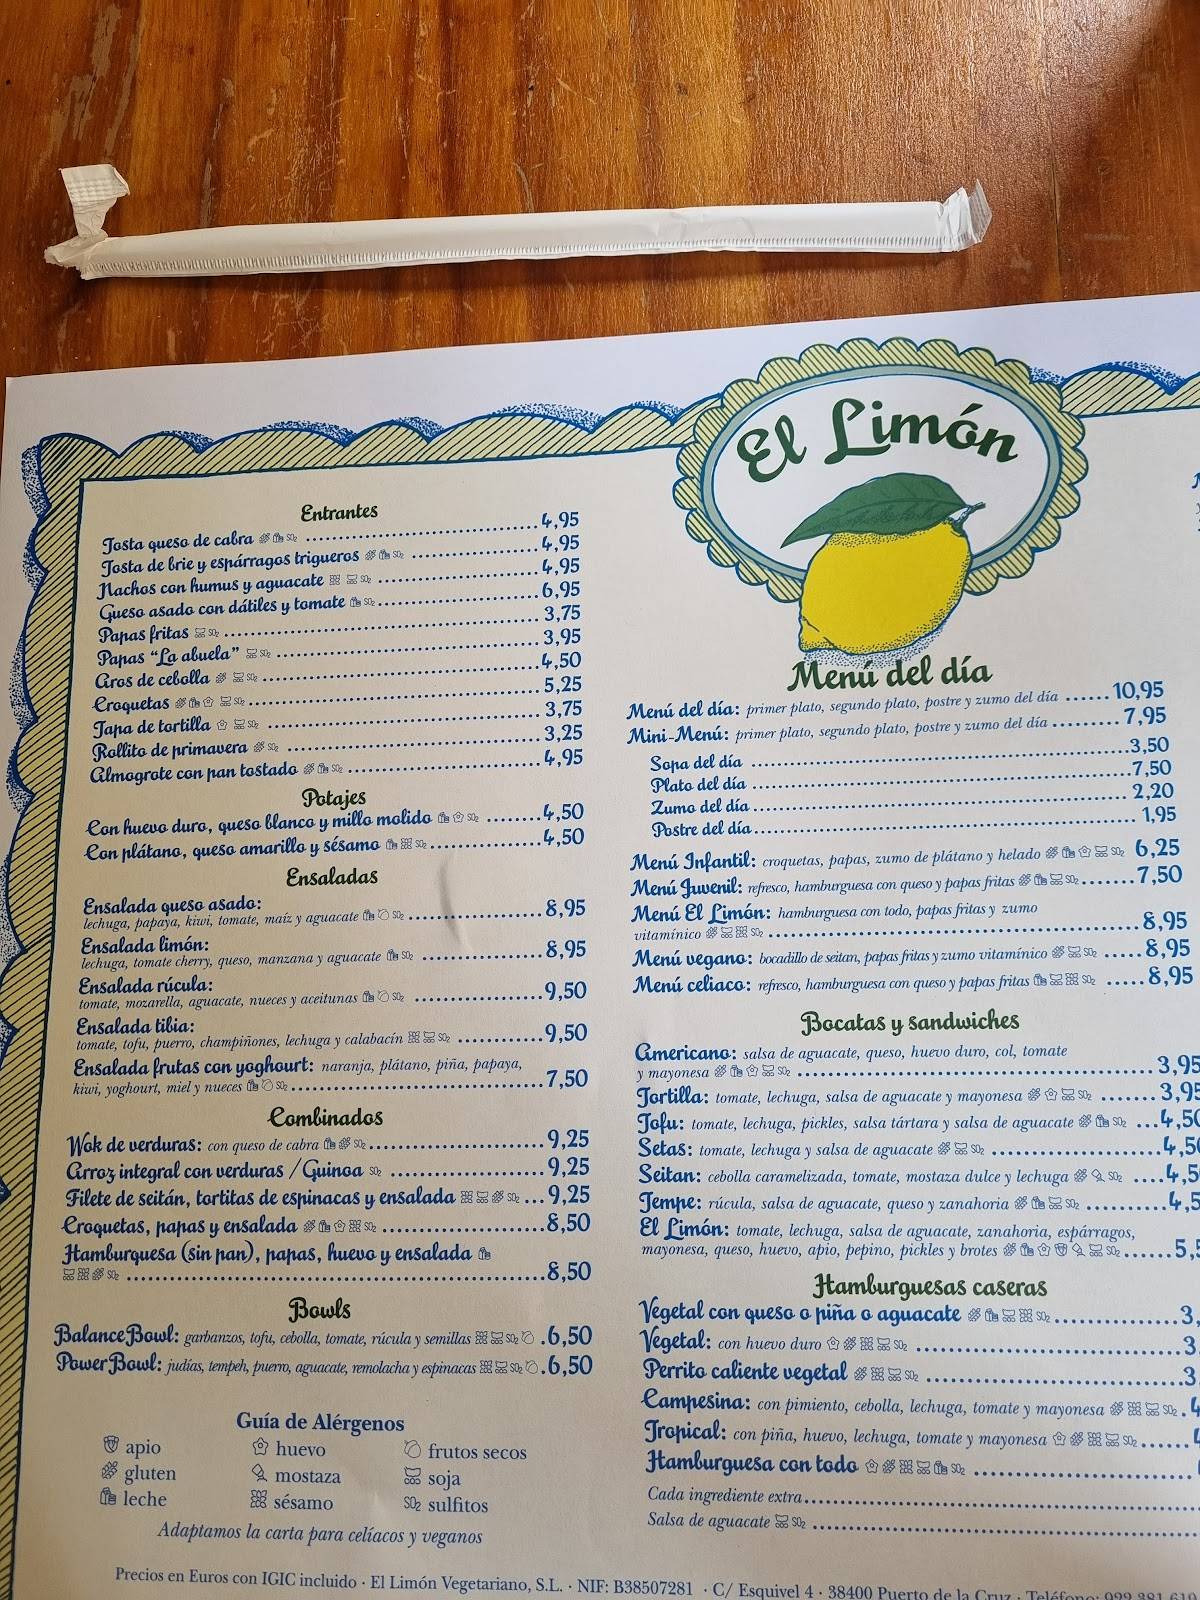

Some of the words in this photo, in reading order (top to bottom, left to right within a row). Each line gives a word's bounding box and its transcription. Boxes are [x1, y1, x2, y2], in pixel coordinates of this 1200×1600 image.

[736, 414, 807, 483] El
[823, 398, 1019, 465] Limón
[301, 503, 378, 522] Entrantes
[102, 537, 146, 555] Tosta
[148, 537, 190, 554] queso
[192, 533, 211, 548] de
[214, 530, 255, 547] cabra
[541, 511, 579, 530] 4,95
[101, 559, 145, 578] Tosta
[147, 558, 165, 572] de
[168, 555, 195, 572] brie
[197, 561, 208, 574] y
[210, 553, 291, 572] espárragos
[294, 550, 360, 568] trigueros
[542, 534, 580, 553] 4,95
[96, 579, 156, 601] Nachos
[160, 584, 188, 595] con
[190, 576, 239, 593] humus
[243, 581, 253, 595] y
[255, 573, 325, 594] aguacate
[542, 557, 580, 576] 4,95
[97, 649, 145, 669] Papas
[543, 628, 581, 647] 3,95
[786, 659, 880, 692] Menú
[886, 654, 1034, 688] del
[940, 655, 994, 685] día
[91, 696, 170, 715] Croquetas
[544, 675, 582, 695] 5,25
[626, 702, 676, 720] Menú
[678, 699, 704, 718] del
[707, 700, 740, 717] día:
[746, 703, 788, 719] primer
[789, 701, 824, 717] plato,
[829, 698, 881, 715] segundo
[883, 697, 920, 713] plato,
[924, 696, 962, 712] postre
[964, 697, 972, 710] y
[975, 696, 1010, 705] zumo
[1014, 691, 1034, 703] del
[1036, 690, 1059, 702] día
[1112, 680, 1164, 701] 10,95
[650, 755, 691, 774] Sopa
[693, 753, 716, 770] del
[718, 754, 744, 769] día
[1129, 736, 1170, 755] 3,50
[650, 777, 695, 794] Plato
[696, 775, 720, 792] del
[722, 776, 747, 791] día
[1132, 759, 1172, 778] 7,50
[301, 787, 367, 811] Potajes
[83, 843, 119, 861] Con
[121, 842, 187, 863] plátano,
[192, 844, 237, 861] queso
[239, 836, 307, 856] amarillo
[310, 843, 320, 858] y
[323, 835, 382, 853] sésamo
[543, 827, 585, 848] 4,50
[286, 866, 378, 887] Ensaladas
[83, 896, 158, 916] Ensalada
[161, 899, 206, 917] queso
[208, 894, 261, 911] asado:
[83, 917, 130, 933] lechuga,
[134, 917, 181, 932] papaya,
[185, 914, 213, 928] kiwi,
[218, 915, 259, 927] tomate,
[265, 912, 292, 924] maíz
[294, 915, 302, 927] y
[305, 911, 359, 927] aguacate
[545, 898, 586, 919] 8,95
[631, 949, 683, 967] Menú
[686, 953, 753, 971] vegano:
[759, 951, 808, 965] bocadillo
[810, 951, 824, 964] de
[824, 950, 861, 965] seitan,
[863, 951, 899, 967] papas
[898, 949, 931, 966] fritas
[931, 952, 939, 966] y
[940, 951, 976, 961] zumo
[978, 947, 1048, 960] vitamínico
[1145, 938, 1191, 960] 8,95
[76, 1016, 153, 1036] Ensalada
[155, 1015, 195, 1034] tibia:
[800, 1010, 886, 1037] Bocatas
[891, 1019, 904, 1037] y
[908, 1008, 1020, 1031] sandwiches
[267, 1106, 383, 1128] Combinados
[66, 1131, 103, 1158] Wok
[105, 1136, 126, 1153] de
[129, 1135, 202, 1152] verduras:
[207, 1142, 228, 1152] con
[232, 1142, 265, 1156] queso
[269, 1138, 283, 1151] de
[286, 1138, 320, 1151] cabra
[547, 1129, 589, 1151] 9,25
[638, 1137, 692, 1158] Setas:
[699, 1145, 745, 1159] tomate,
[751, 1143, 801, 1160] lechuga
[804, 1146, 811, 1160] y
[815, 1142, 850, 1156] salsa
[853, 1142, 869, 1156] de
[872, 1144, 933, 1160] aguacate
[638, 1191, 702, 1214] Tempe:
[709, 1196, 756, 1212] rúcula,
[761, 1196, 795, 1210] salsa
[799, 1196, 814, 1210] de
[817, 1198, 881, 1214] aguacate,
[887, 1200, 924, 1215] queso
[927, 1200, 935, 1214] y
[939, 1196, 1009, 1210] zanahoria
[812, 1272, 967, 1302] Hamburguesas
[972, 1280, 1048, 1297] caseras
[288, 1296, 351, 1324] Bowls
[642, 1357, 708, 1379] Perrito
[711, 1359, 780, 1380] caliente
[783, 1360, 848, 1387] vegetal
[236, 1411, 280, 1429] Guía
[285, 1412, 308, 1430] de
[311, 1413, 405, 1437] Alérgenos
[126, 1439, 161, 1460] apio
[276, 1440, 326, 1457] huevo
[428, 1443, 478, 1459] frutos
[483, 1448, 527, 1460] secos
[124, 1464, 176, 1486] gluten
[275, 1470, 341, 1484] mostaza
[428, 1469, 462, 1491] soja
[123, 1490, 167, 1507] leche
[274, 1493, 333, 1511] sésamo
[428, 1496, 488, 1513] sulfitos
[648, 1486, 685, 1501] Cada
[689, 1487, 764, 1506] ingrediente
[768, 1491, 802, 1504] extra
[157, 1521, 242, 1543] Adaptamos
[246, 1523, 261, 1539] la
[265, 1526, 304, 1541] carta
[307, 1526, 344, 1547] para
[348, 1526, 405, 1543] celíacos
[407, 1532, 417, 1549] y
[422, 1531, 483, 1549] veganos
[116, 1567, 164, 1582] Precios
[167, 1572, 184, 1582] en
[189, 1569, 229, 1584] Euros
[232, 1574, 257, 1585] con
[262, 1571, 296, 1586] IGIC
[300, 1572, 357, 1589] incluido
[370, 1575, 385, 1589] El
[389, 1575, 437, 1590] Limón
[441, 1576, 531, 1595] Vegetariano,
[536, 1577, 563, 1592] S.L.
